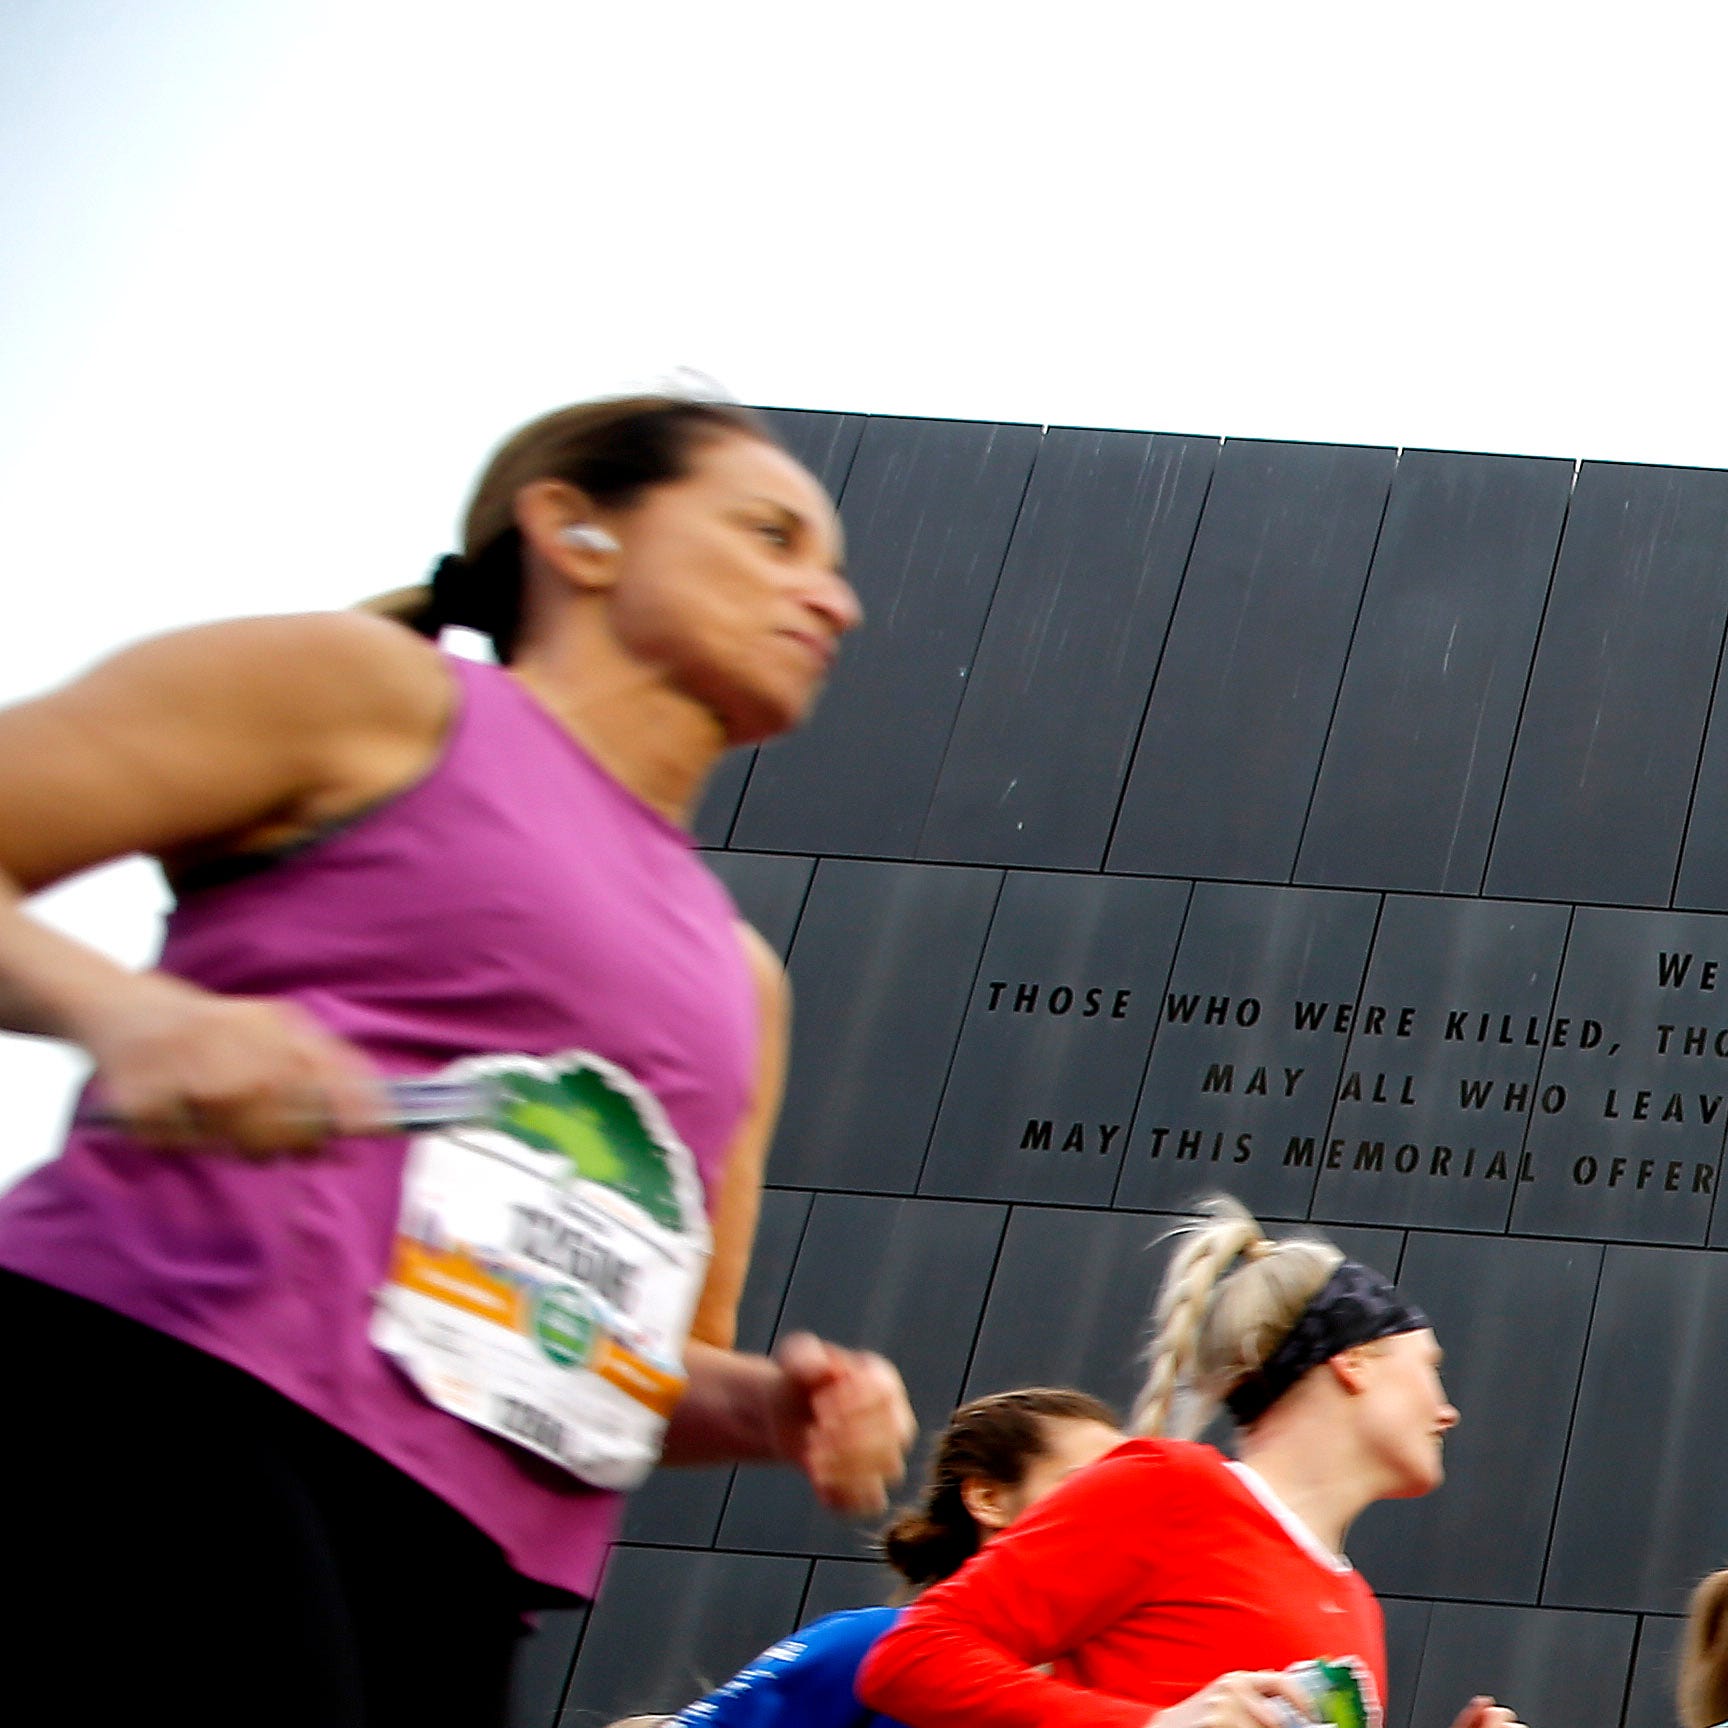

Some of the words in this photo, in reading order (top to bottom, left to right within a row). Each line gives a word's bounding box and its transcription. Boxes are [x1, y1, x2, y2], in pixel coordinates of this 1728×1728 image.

[1658, 952, 1718, 991] WE
[988, 982, 1132, 1020] THOSE
[1165, 994, 1261, 1031] WHO
[1295, 1001, 1416, 1037] WERE
[1445, 1012, 1620, 1056] KILLED,
[1203, 1063, 1306, 1098] MAY
[1341, 1072, 1417, 1106] ALL
[1459, 1079, 1567, 1115] WHO
[1020, 1120, 1124, 1156] MAY
[1151, 1127, 1252, 1165] THIS
[1283, 1137, 1536, 1184] MEMORIAL
[1572, 1154, 1715, 1194] OFFER
